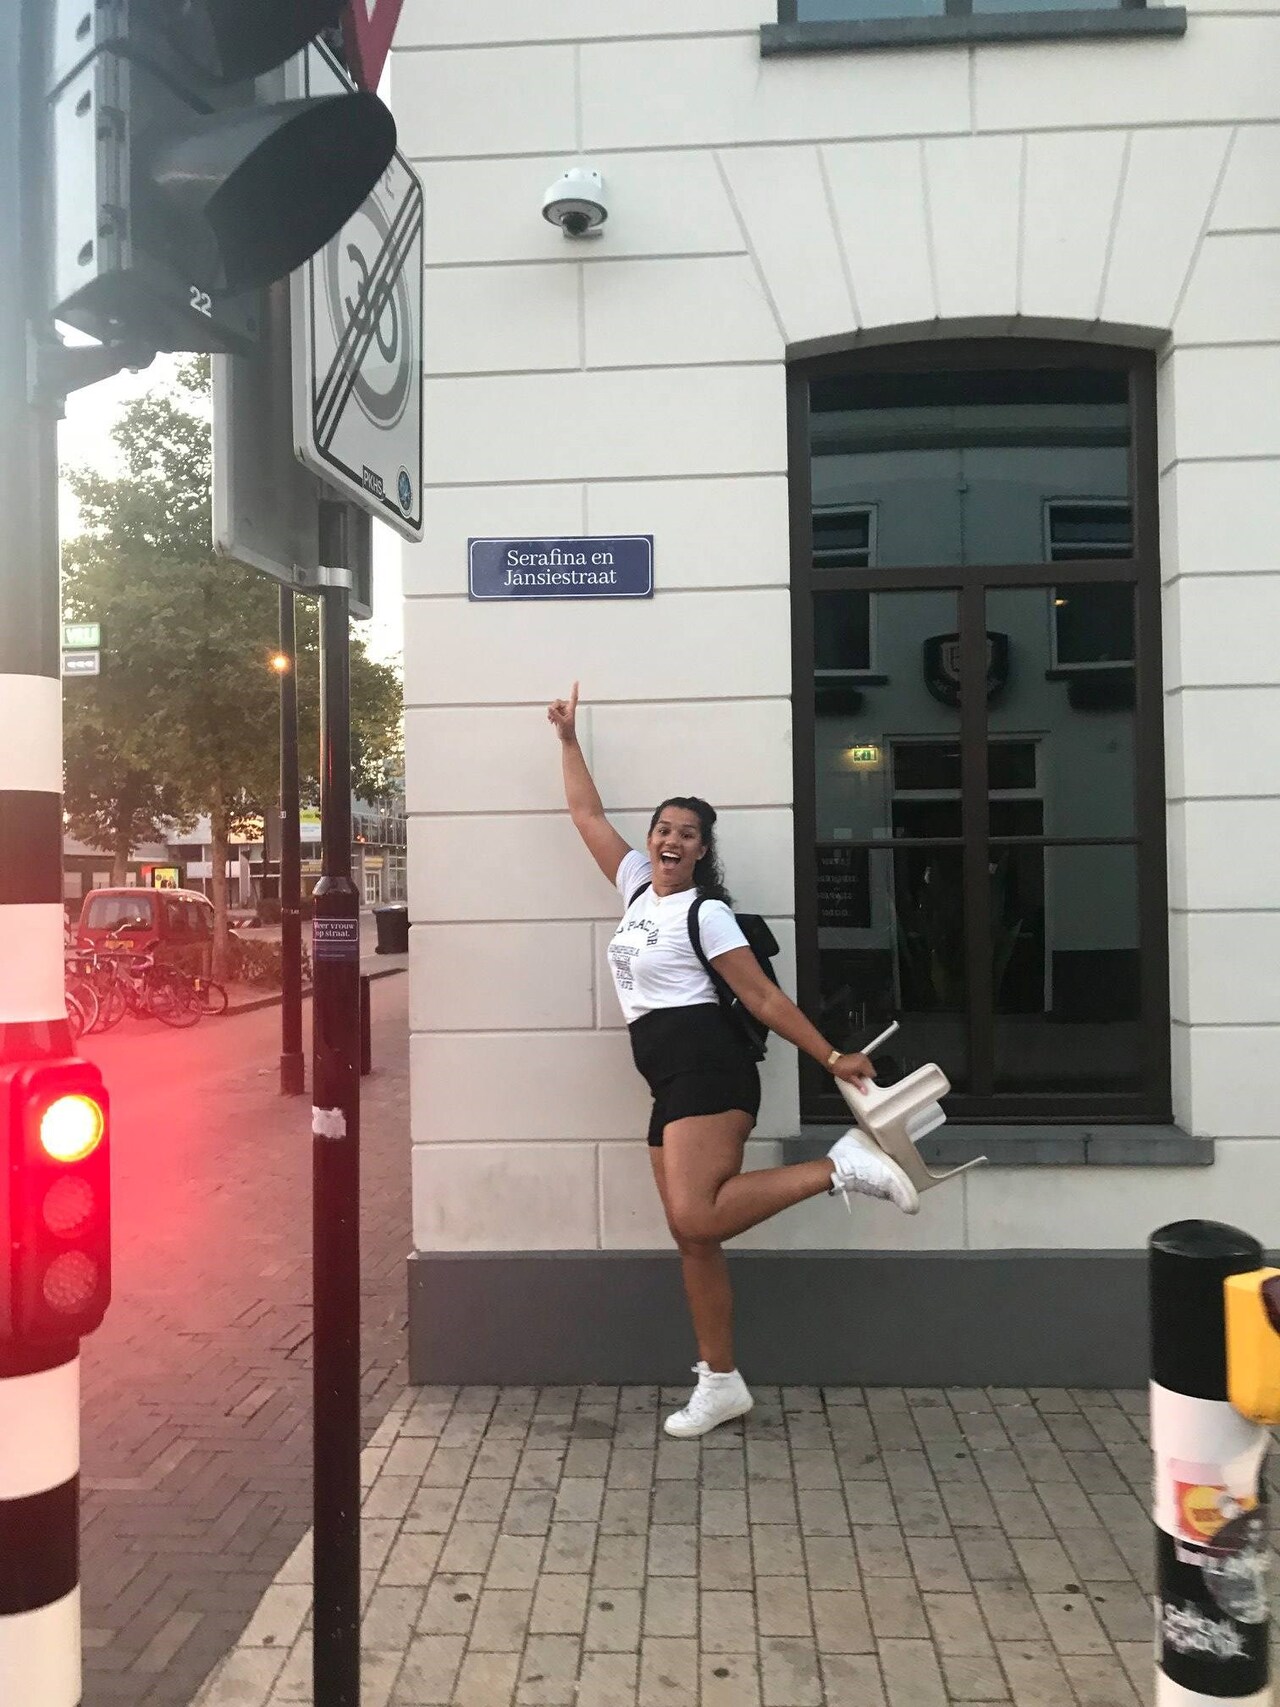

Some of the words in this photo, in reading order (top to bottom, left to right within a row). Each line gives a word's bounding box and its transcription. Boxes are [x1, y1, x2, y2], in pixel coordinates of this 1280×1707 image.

[189, 285, 212, 318] 22
[507, 548, 587, 567] Serafina
[591, 551, 614, 566] en
[504, 568, 617, 587] Jansiestraat
